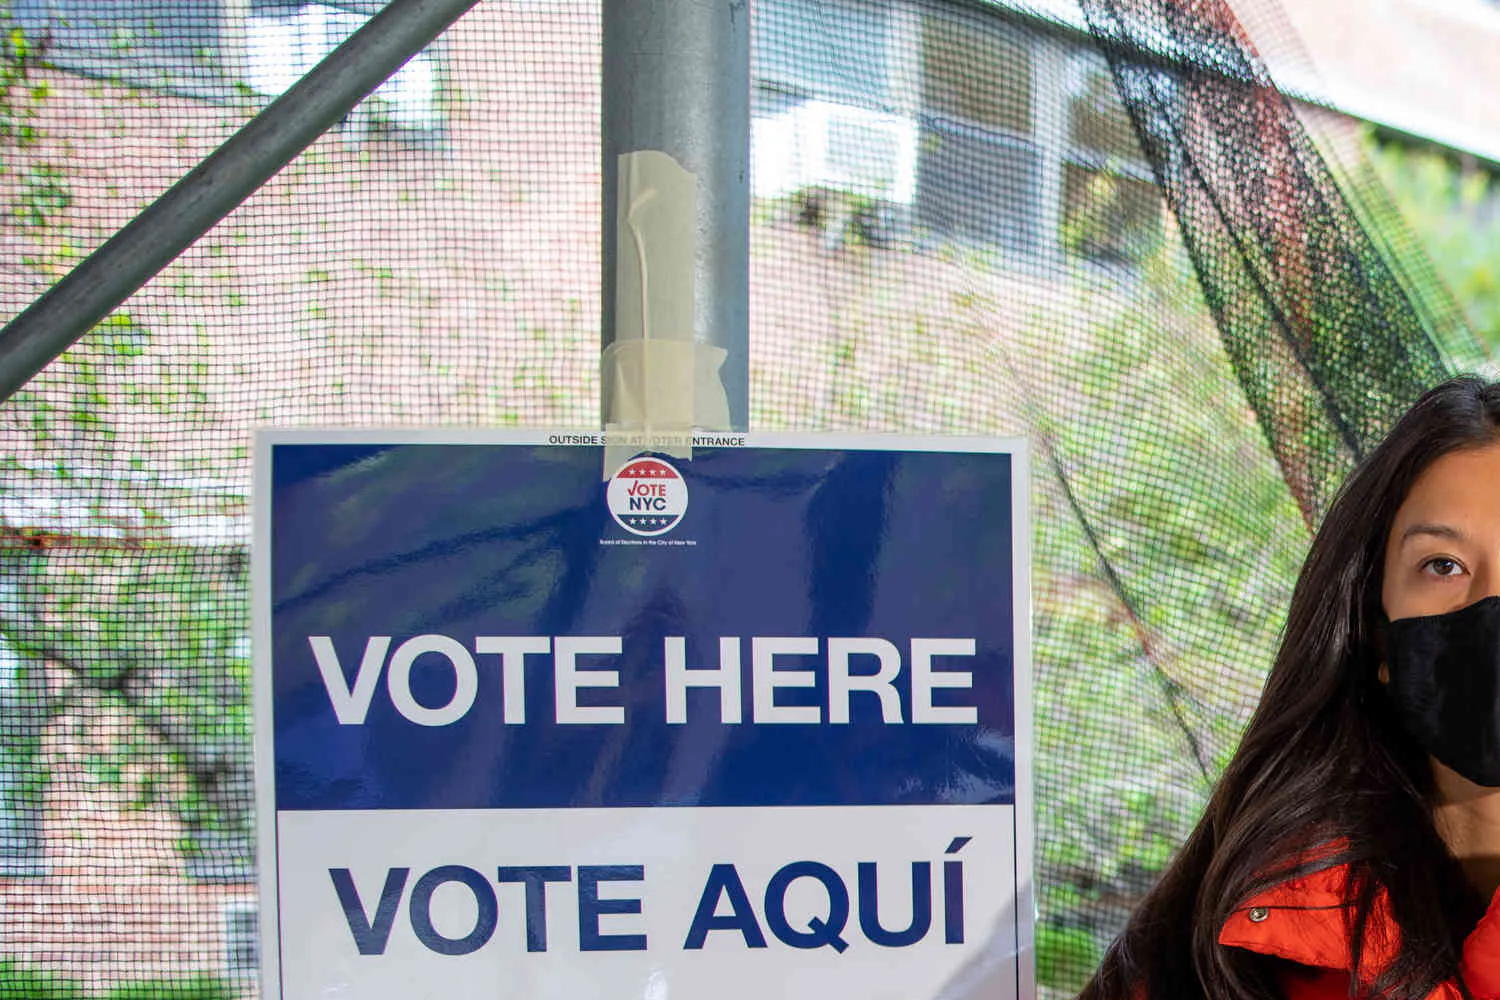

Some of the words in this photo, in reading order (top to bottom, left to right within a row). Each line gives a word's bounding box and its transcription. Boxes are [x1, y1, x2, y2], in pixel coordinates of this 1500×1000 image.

[548, 435, 598, 445] OUTSIDE
[626, 480, 667, 497] VOTE
[629, 497, 666, 511] NYC
[308, 635, 625, 726] VOTE
[665, 636, 979, 726] HERE
[328, 864, 647, 957] VOTE
[682, 836, 973, 955] AQUÍ
